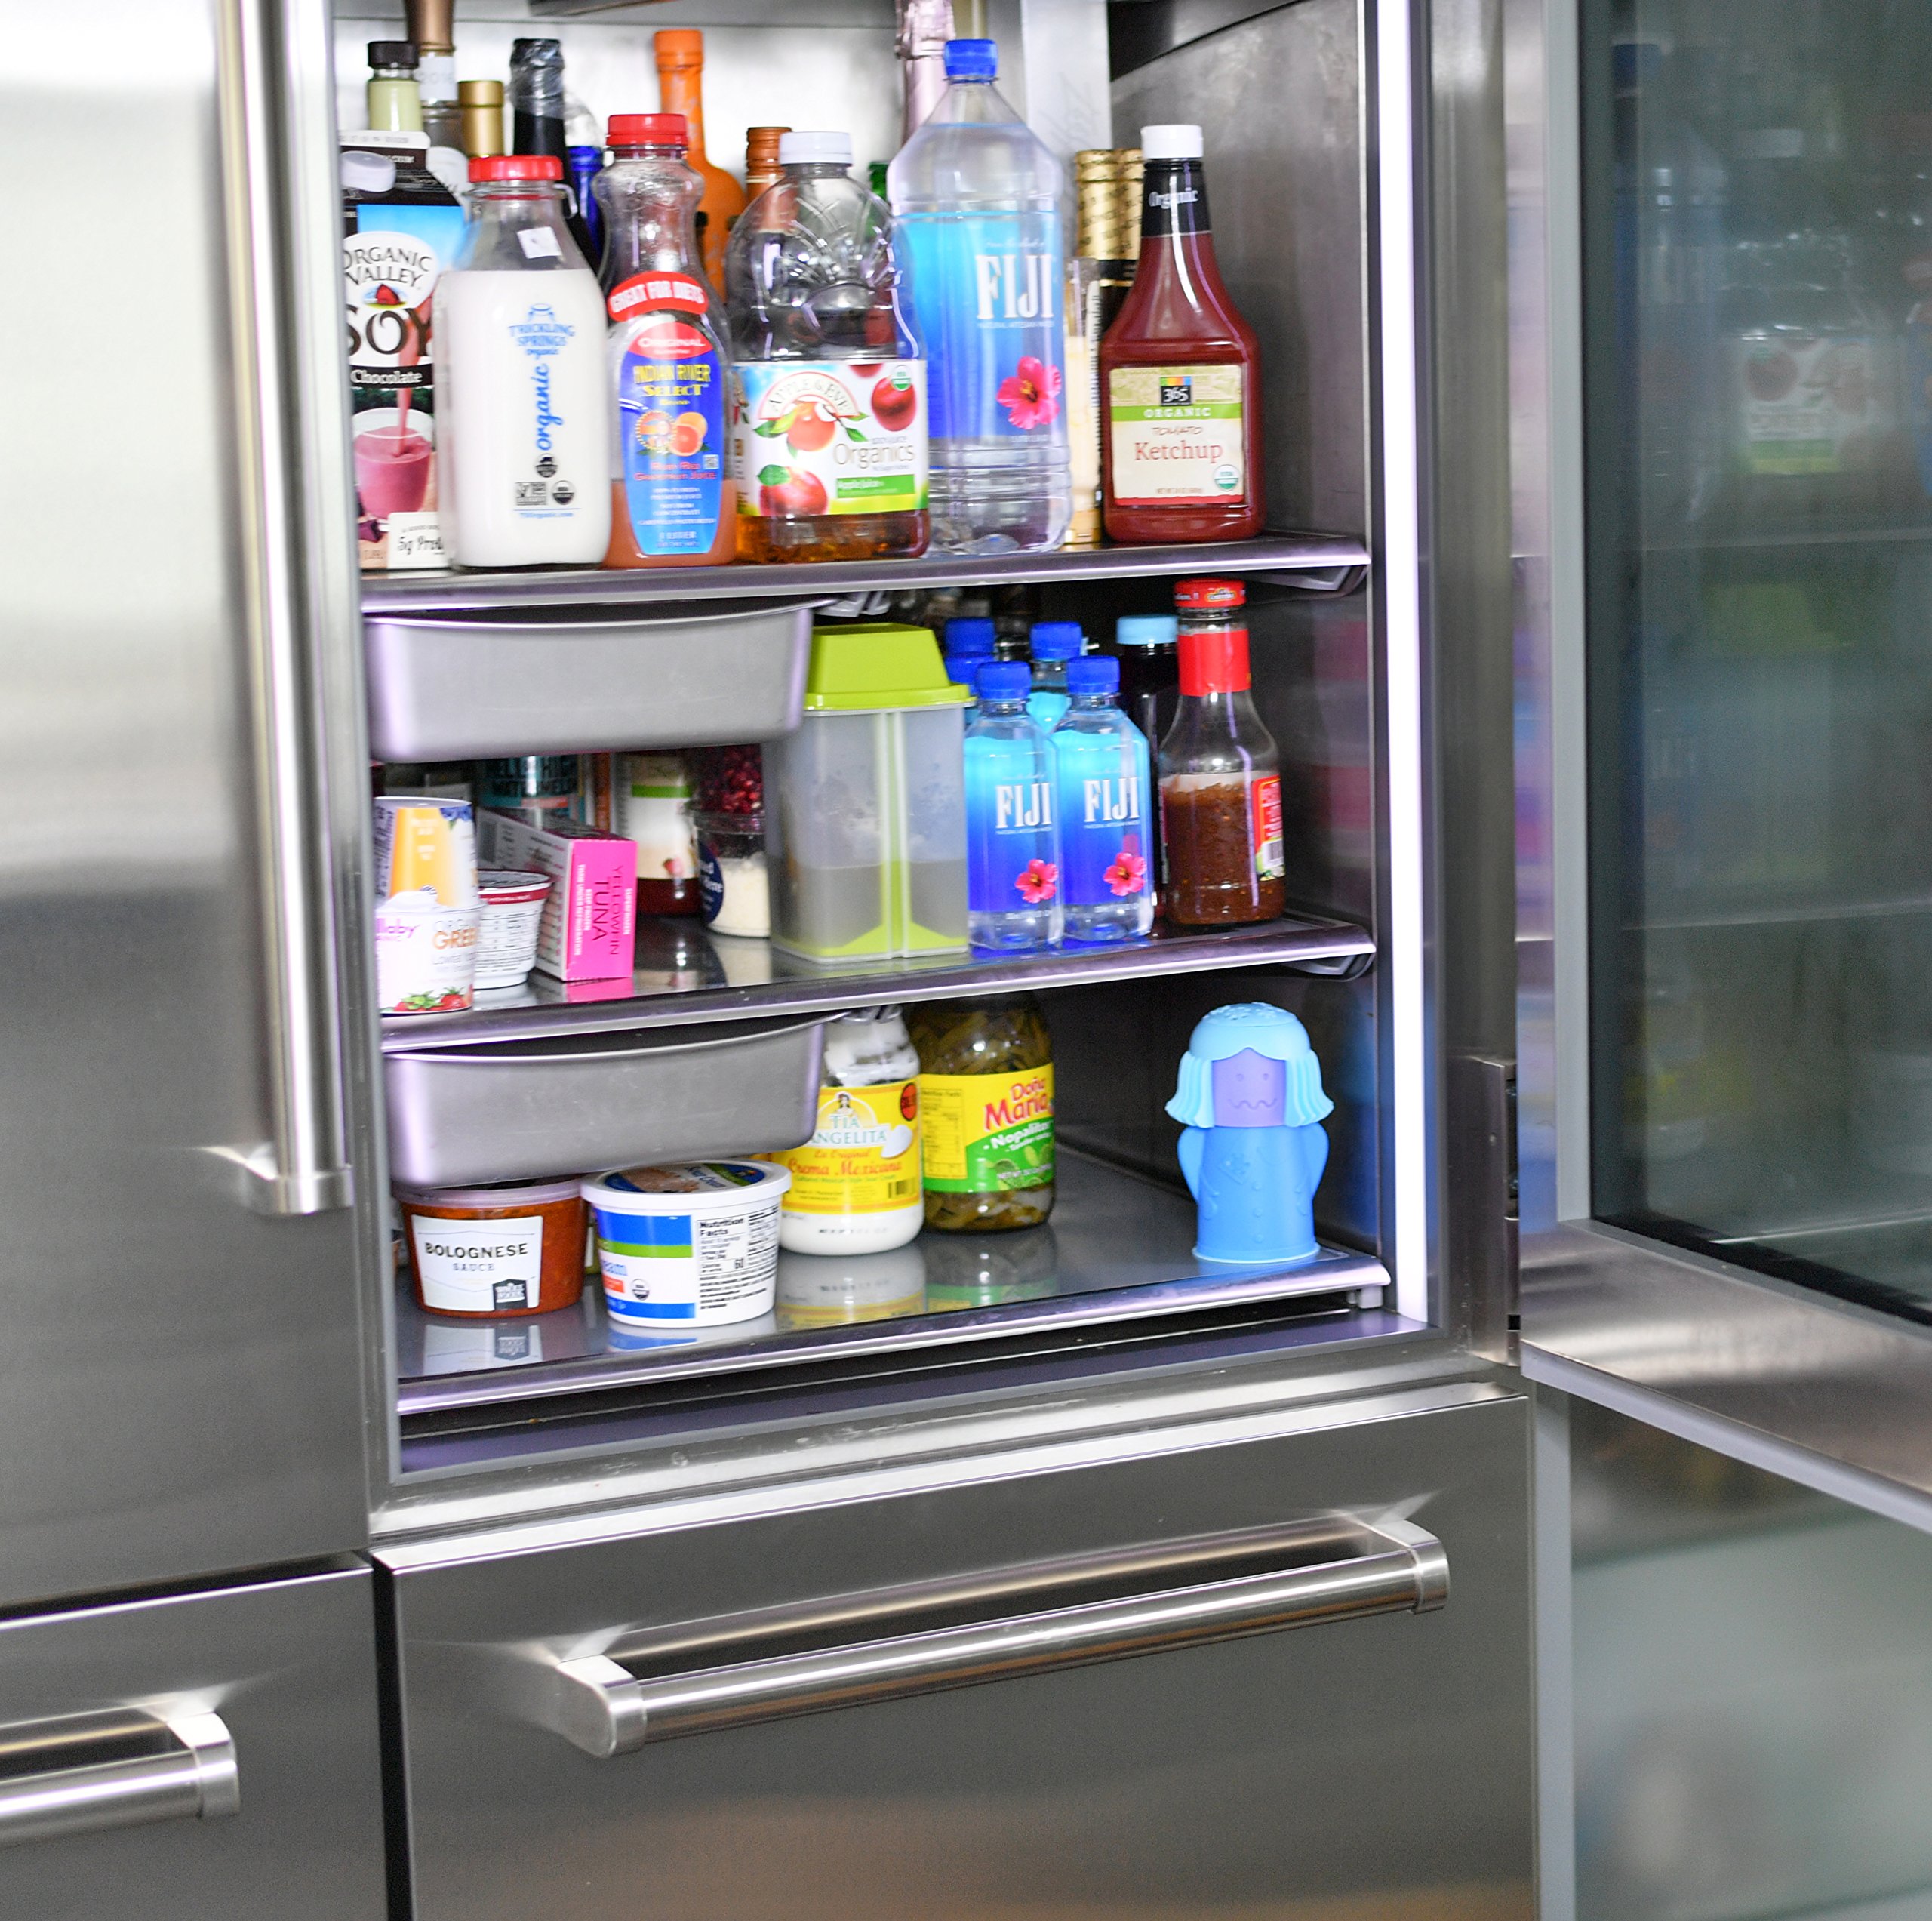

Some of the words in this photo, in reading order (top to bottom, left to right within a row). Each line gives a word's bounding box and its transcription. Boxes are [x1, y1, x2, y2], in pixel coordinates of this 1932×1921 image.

[345, 266, 423, 287] VALLEY
[975, 254, 1054, 319] FIJI
[509, 324, 576, 337] TRICKLING
[517, 335, 568, 346] SPRINGS
[638, 337, 706, 347] ORIGINAL
[349, 369, 423, 384] Chocolate
[634, 365, 675, 384] INDIAN
[677, 364, 711, 383] RIVER
[643, 384, 702, 396] SELECT
[1163, 386, 1189, 403] 365
[530, 363, 565, 451] organic
[1143, 408, 1212, 418] ORGANIC
[1152, 426, 1203, 436] TOMATO
[833, 444, 915, 469] Organics
[1134, 440, 1224, 464] Ketchup
[995, 783, 1052, 828] FIJI
[1084, 777, 1140, 822] FIJI
[592, 881, 609, 941] TUNA
[609, 865, 623, 955] YELLOWFIN
[831, 1115, 860, 1129] TIA
[835, 1159, 903, 1177] Mexicana
[700, 1218, 744, 1228] Nutrition
[700, 1229, 728, 1237] Facts
[424, 1242, 528, 1259] BOLOGNESE
[453, 1263, 495, 1272] SAUCE
